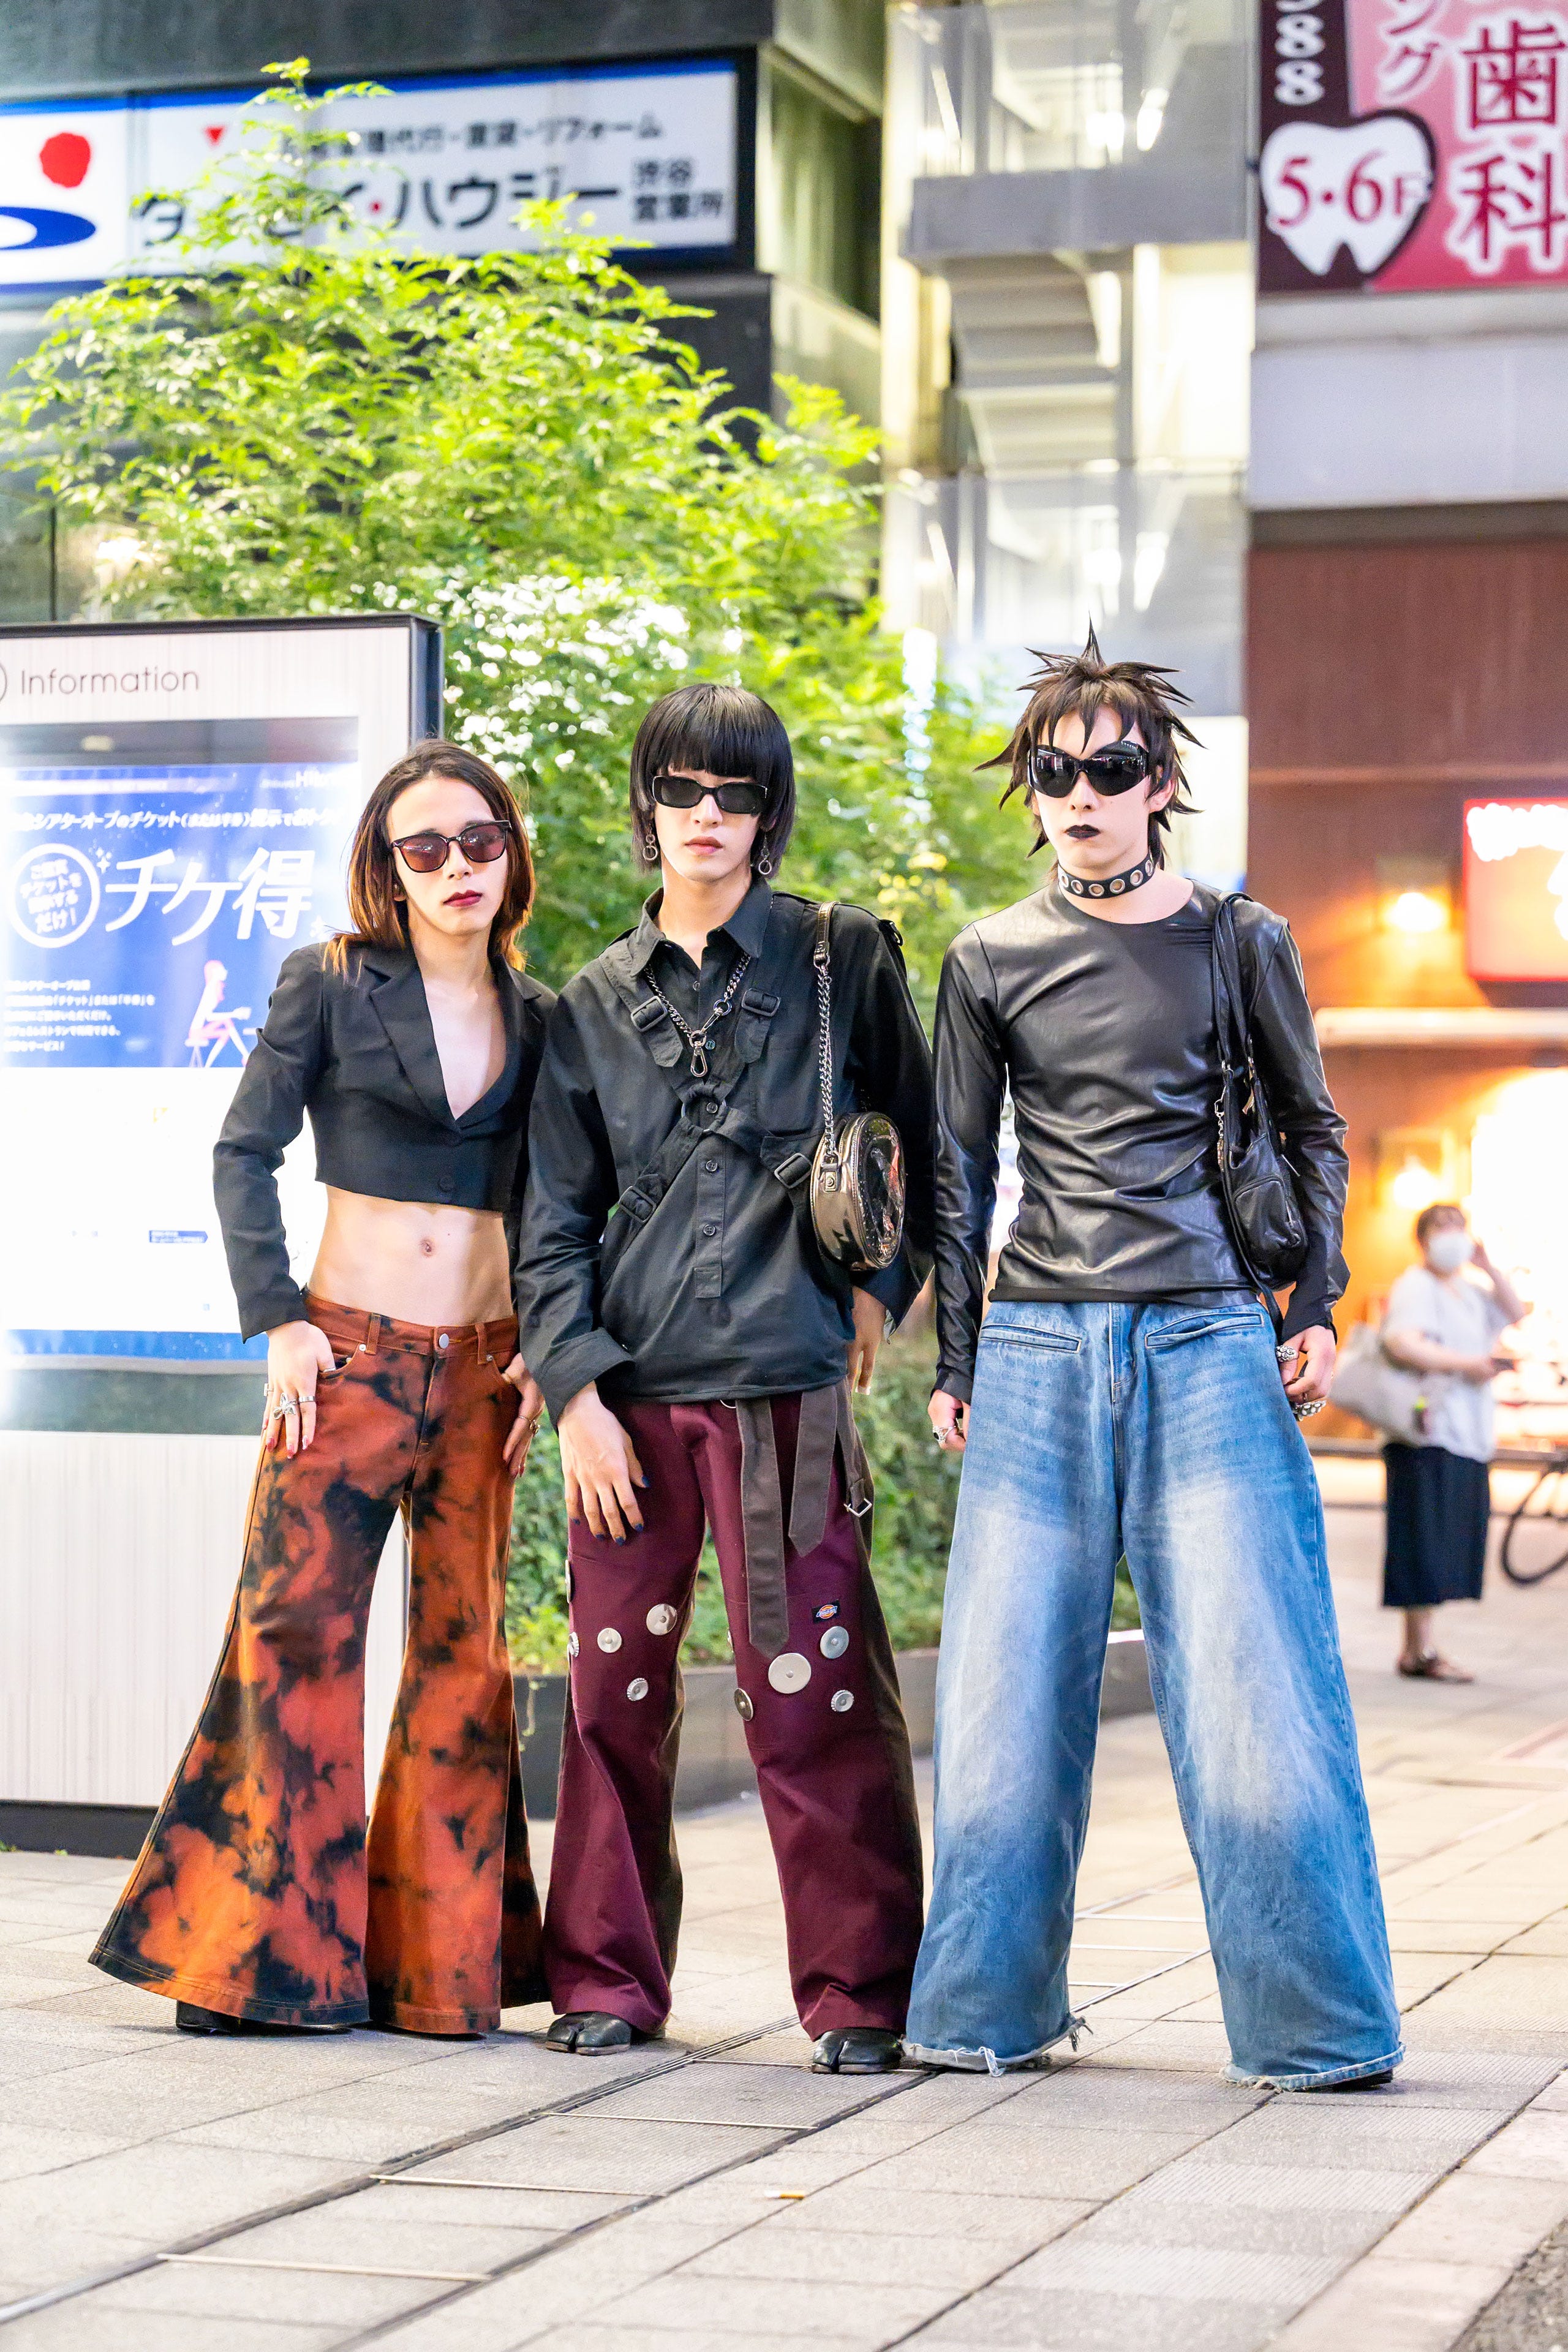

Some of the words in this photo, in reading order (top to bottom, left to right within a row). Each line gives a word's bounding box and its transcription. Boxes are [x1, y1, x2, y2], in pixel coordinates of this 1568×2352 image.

[1461, 20, 1567, 260] 歯科
[21, 665, 200, 695] Information
[105, 846, 315, 946] チケ得
